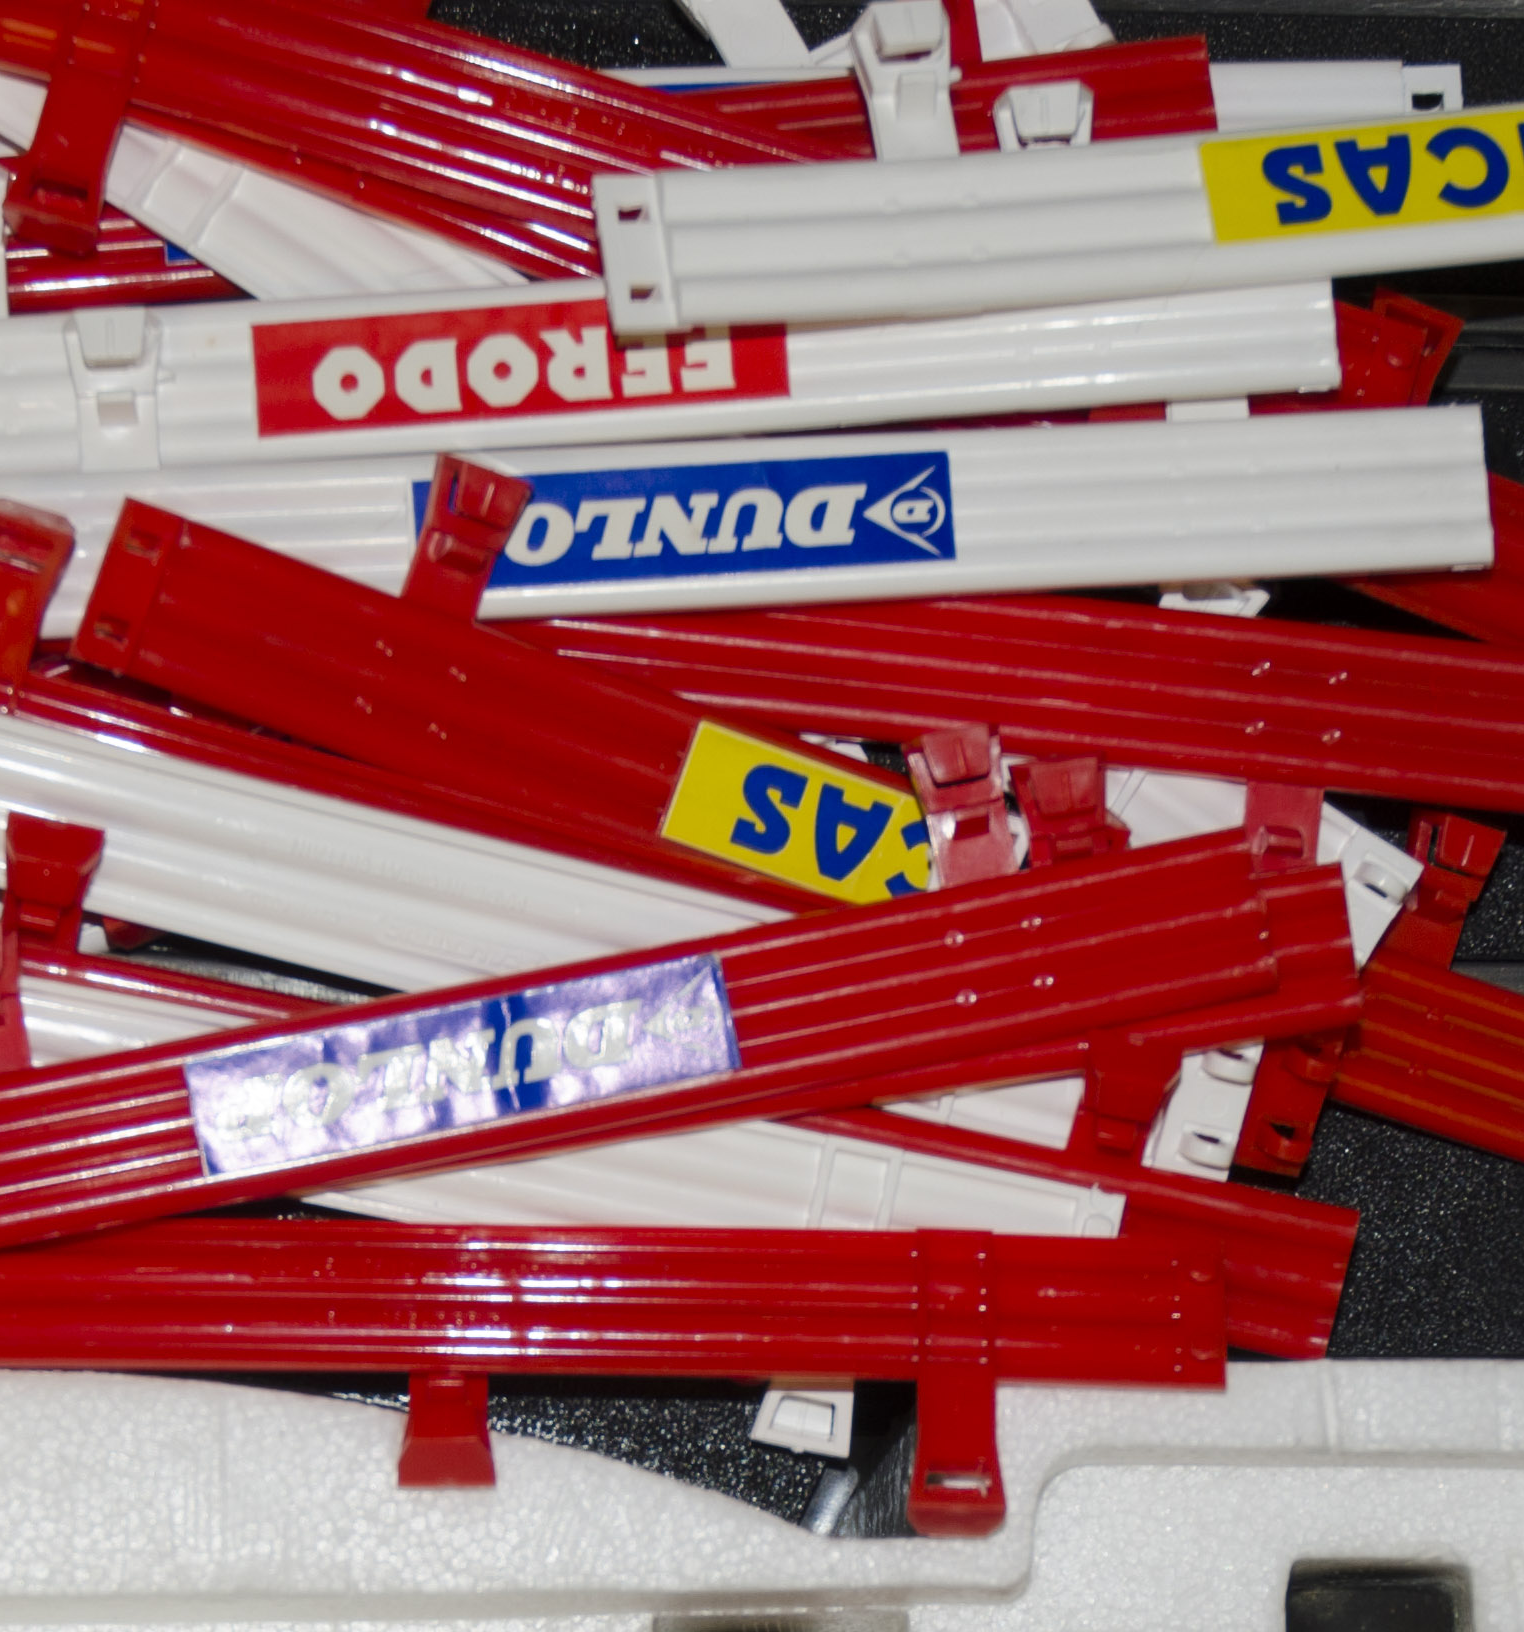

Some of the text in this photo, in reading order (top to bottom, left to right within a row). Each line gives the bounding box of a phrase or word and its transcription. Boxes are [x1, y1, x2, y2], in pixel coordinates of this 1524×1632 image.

[312, 326, 736, 421] FERODO
[504, 484, 868, 567] DUNLO
[730, 764, 931, 898] CAS
[215, 998, 644, 1141] DUNLOP
